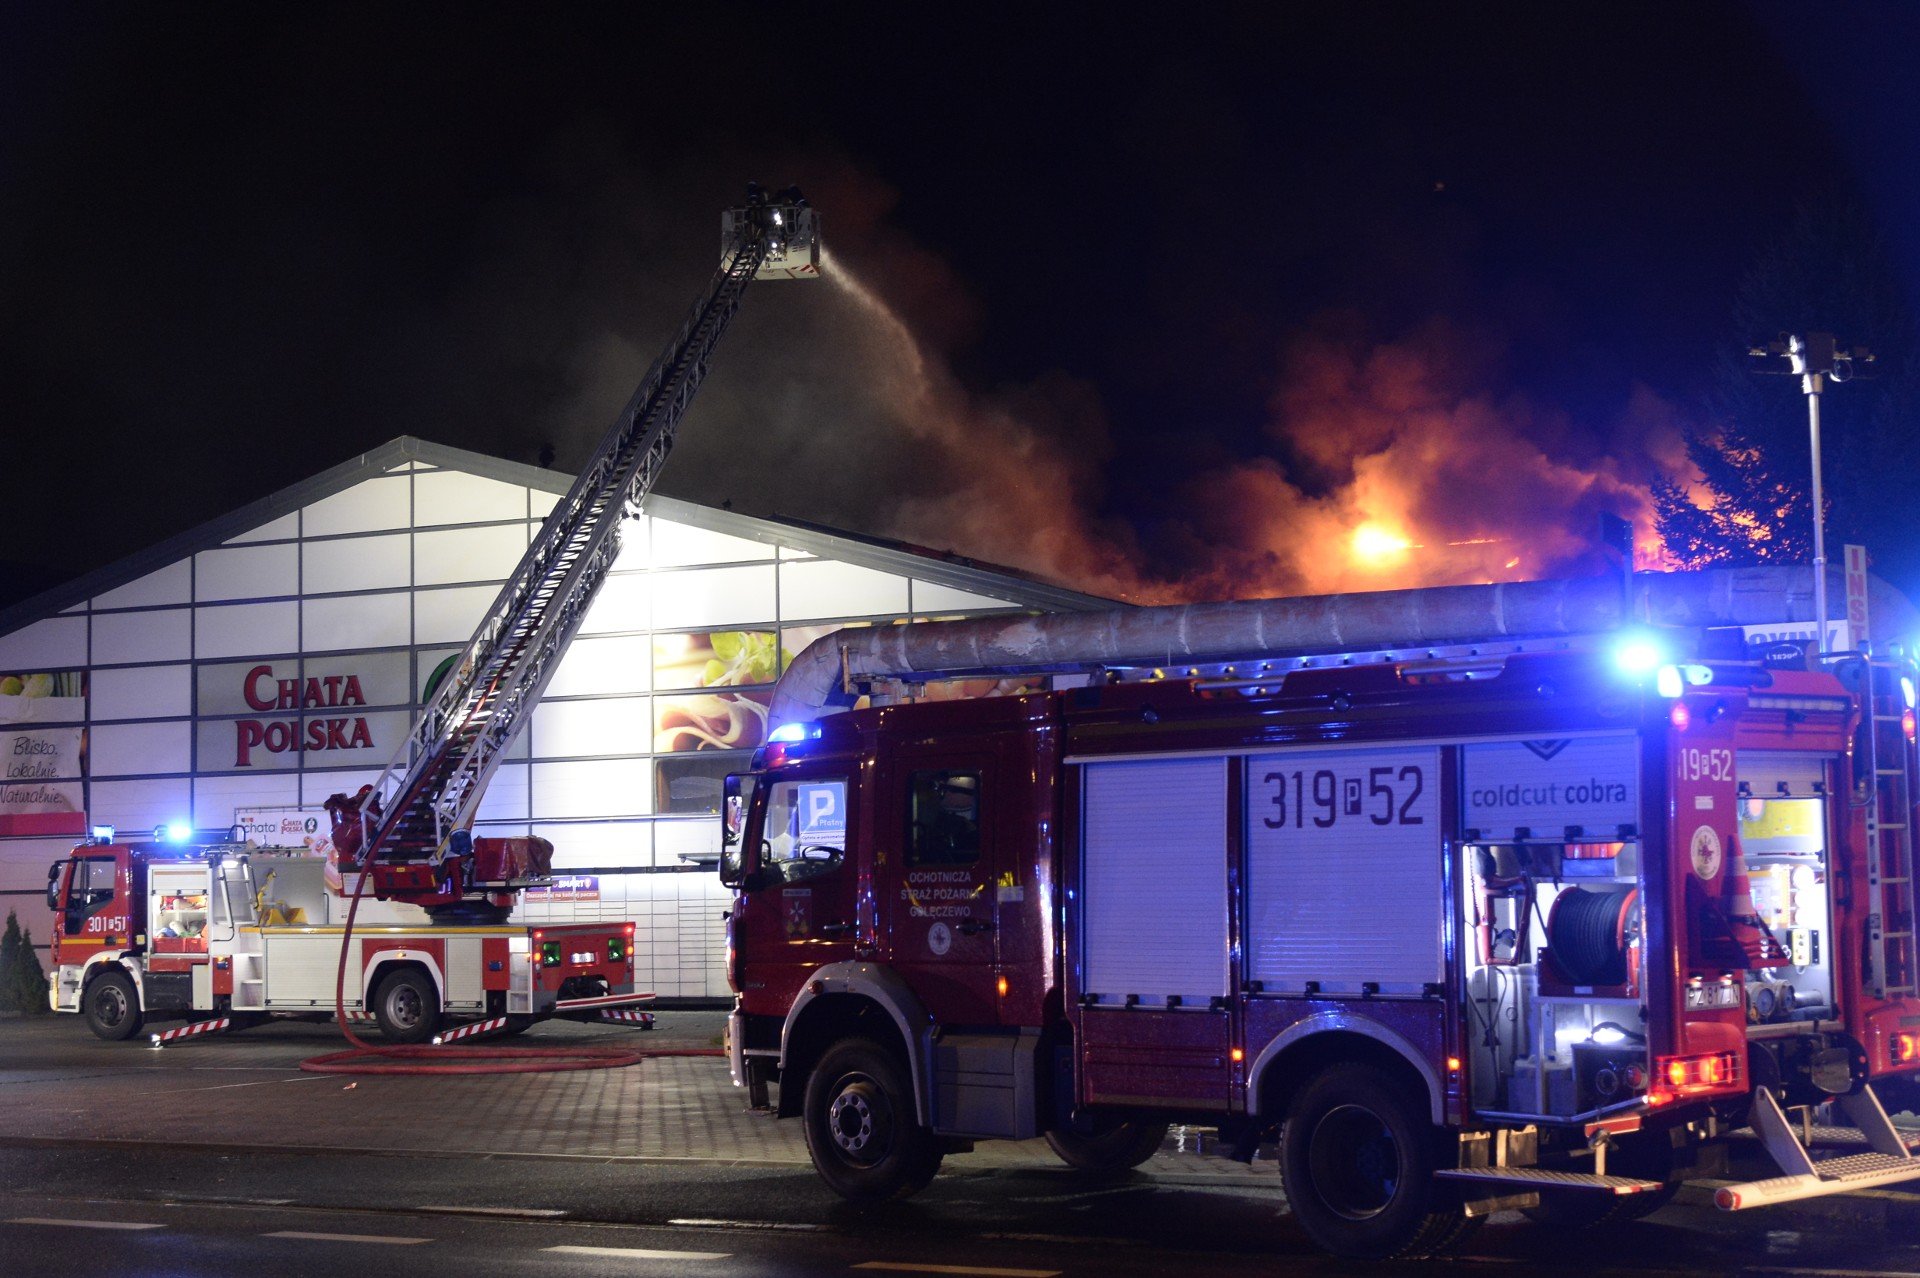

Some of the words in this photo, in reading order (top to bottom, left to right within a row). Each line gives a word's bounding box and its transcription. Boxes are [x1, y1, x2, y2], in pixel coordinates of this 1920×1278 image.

[243, 664, 366, 711] CHATA
[234, 717, 375, 767] POLSKA
[1472, 783, 1557, 807] coldcut
[1565, 778, 1626, 804] cobra
[909, 872, 971, 883] OCHOTNICZA
[901, 887, 931, 900] STRAŻ
